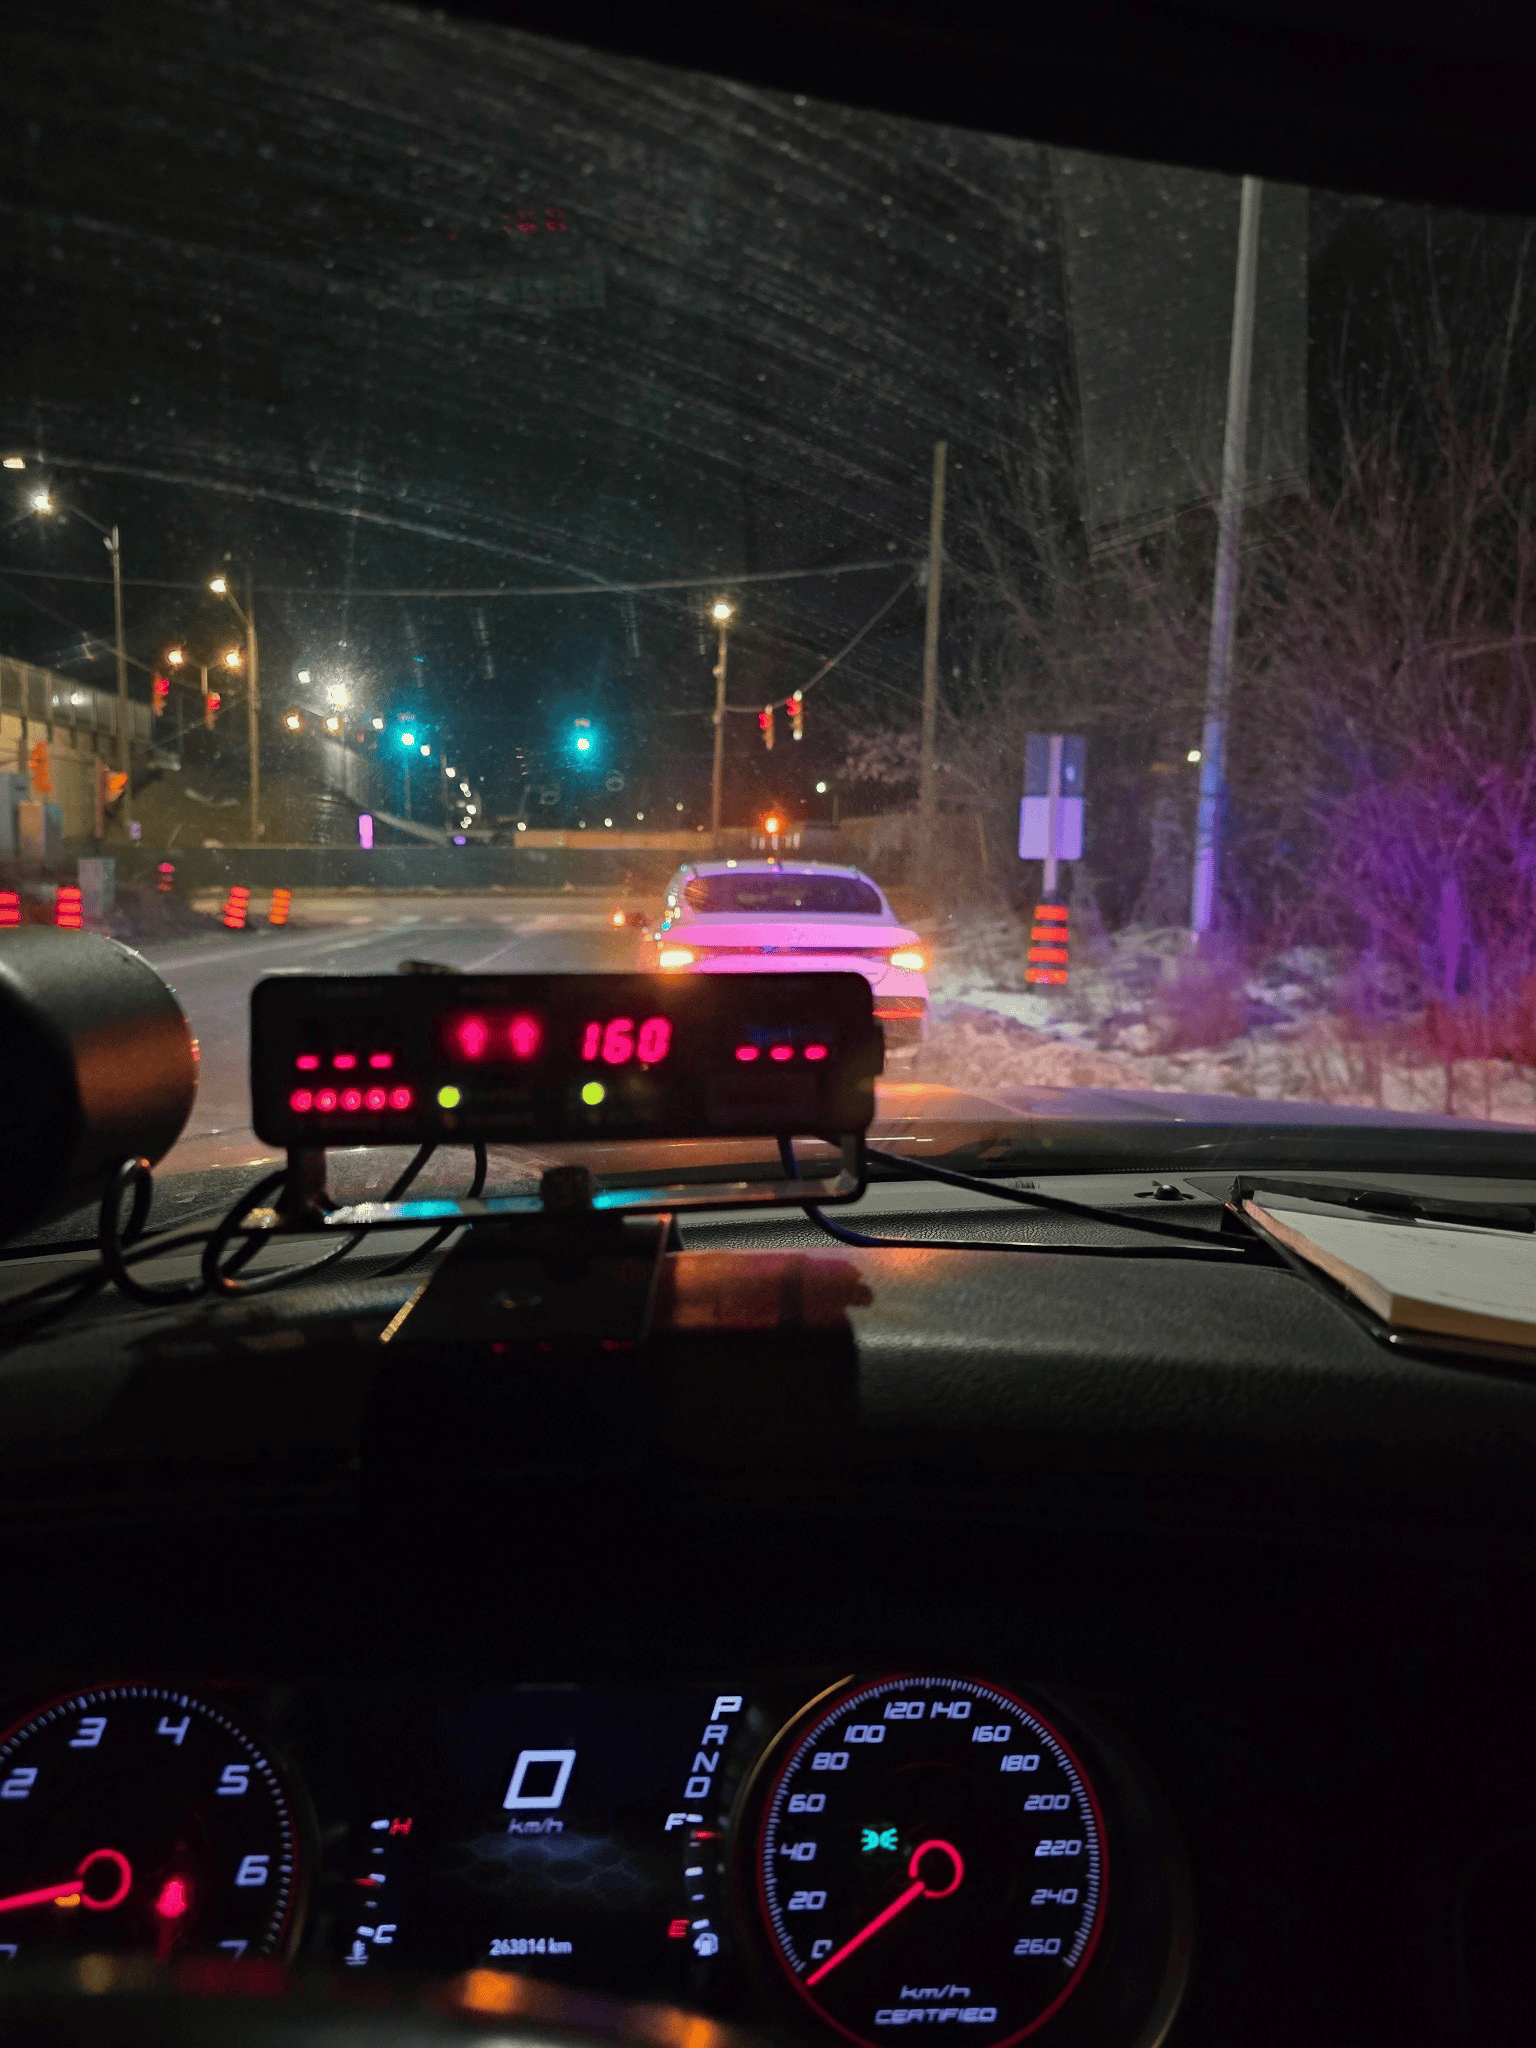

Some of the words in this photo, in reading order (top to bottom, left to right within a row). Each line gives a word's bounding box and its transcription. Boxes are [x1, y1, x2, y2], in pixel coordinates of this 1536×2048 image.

[582, 1017, 671, 1064] 160
[711, 1696, 743, 1720] P
[884, 1702, 925, 1719] 120
[930, 1702, 971, 1719] 140
[69, 1717, 107, 1747] 3
[157, 1716, 190, 1745] 4
[702, 1725, 728, 1745] R
[844, 1725, 886, 1743] 100
[972, 1726, 1011, 1742] 160
[692, 1752, 719, 1772] N
[812, 1752, 849, 1770] 80
[1000, 1755, 1040, 1771] 180
[0, 1767, 38, 1798] 2
[216, 1765, 250, 1795] 5
[503, 1750, 576, 1809] 0
[684, 1777, 710, 1798] D
[788, 1795, 826, 1813] 60
[1024, 1794, 1070, 1811] 200
[389, 1818, 412, 1835] H
[507, 1818, 563, 1834] km/h
[665, 1813, 687, 1830] F
[780, 1842, 817, 1861] 40
[1035, 1840, 1082, 1856] 220
[236, 1855, 269, 1886] 6
[788, 1891, 827, 1910] 20
[1031, 1889, 1079, 1905] 240
[374, 1924, 396, 1943] C
[668, 1919, 689, 1938] E
[490, 1938, 545, 1956] 263814
[548, 1938, 572, 1954] km
[1014, 1938, 1061, 1955] 260
[900, 1985, 970, 1999] km/h
[875, 2007, 997, 2025] CERTIFIED
